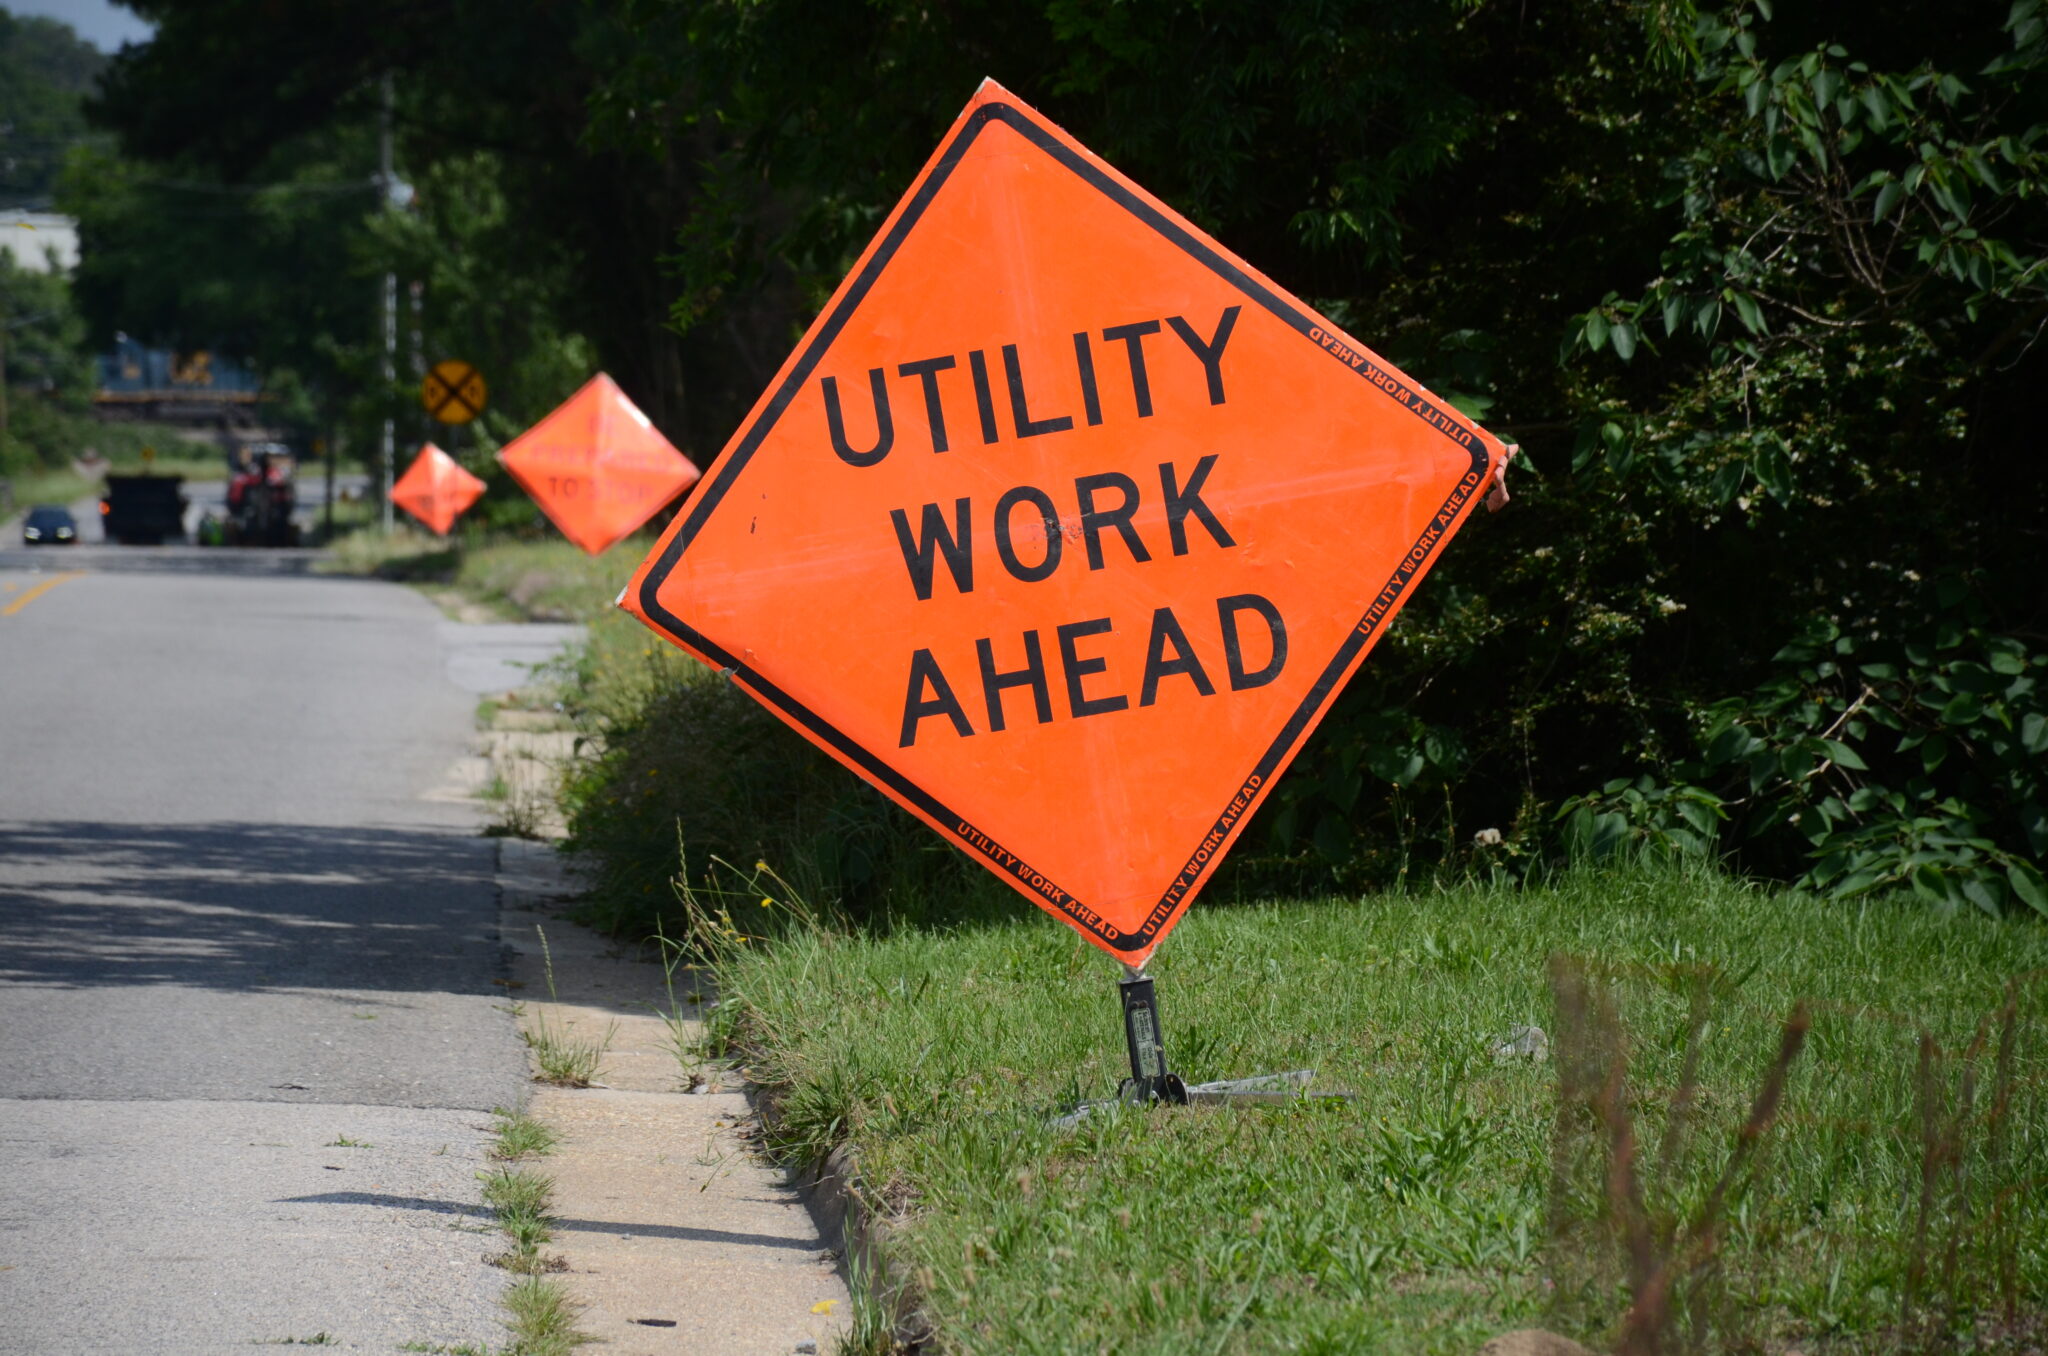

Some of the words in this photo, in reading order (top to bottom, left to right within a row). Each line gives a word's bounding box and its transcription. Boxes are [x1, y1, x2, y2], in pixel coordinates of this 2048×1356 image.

[821, 305, 1242, 468] UTILITY
[1309, 327, 1365, 368] AHEAD
[1362, 363, 1411, 404] WORK
[1411, 399, 1473, 447] UTILITY
[889, 453, 1237, 601] WORK
[1357, 574, 1404, 635] UTILITY
[1401, 526, 1441, 575] WORK
[1437, 471, 1479, 527] AHEAD
[898, 593, 1288, 748] AHEAD
[957, 821, 1017, 867] UTILITY
[1017, 863, 1064, 904] WORK
[1065, 899, 1119, 941] AHEAD
[1142, 876, 1190, 937] UTILITY
[1185, 828, 1224, 877] WORK
[1220, 774, 1262, 829] AHEAD
